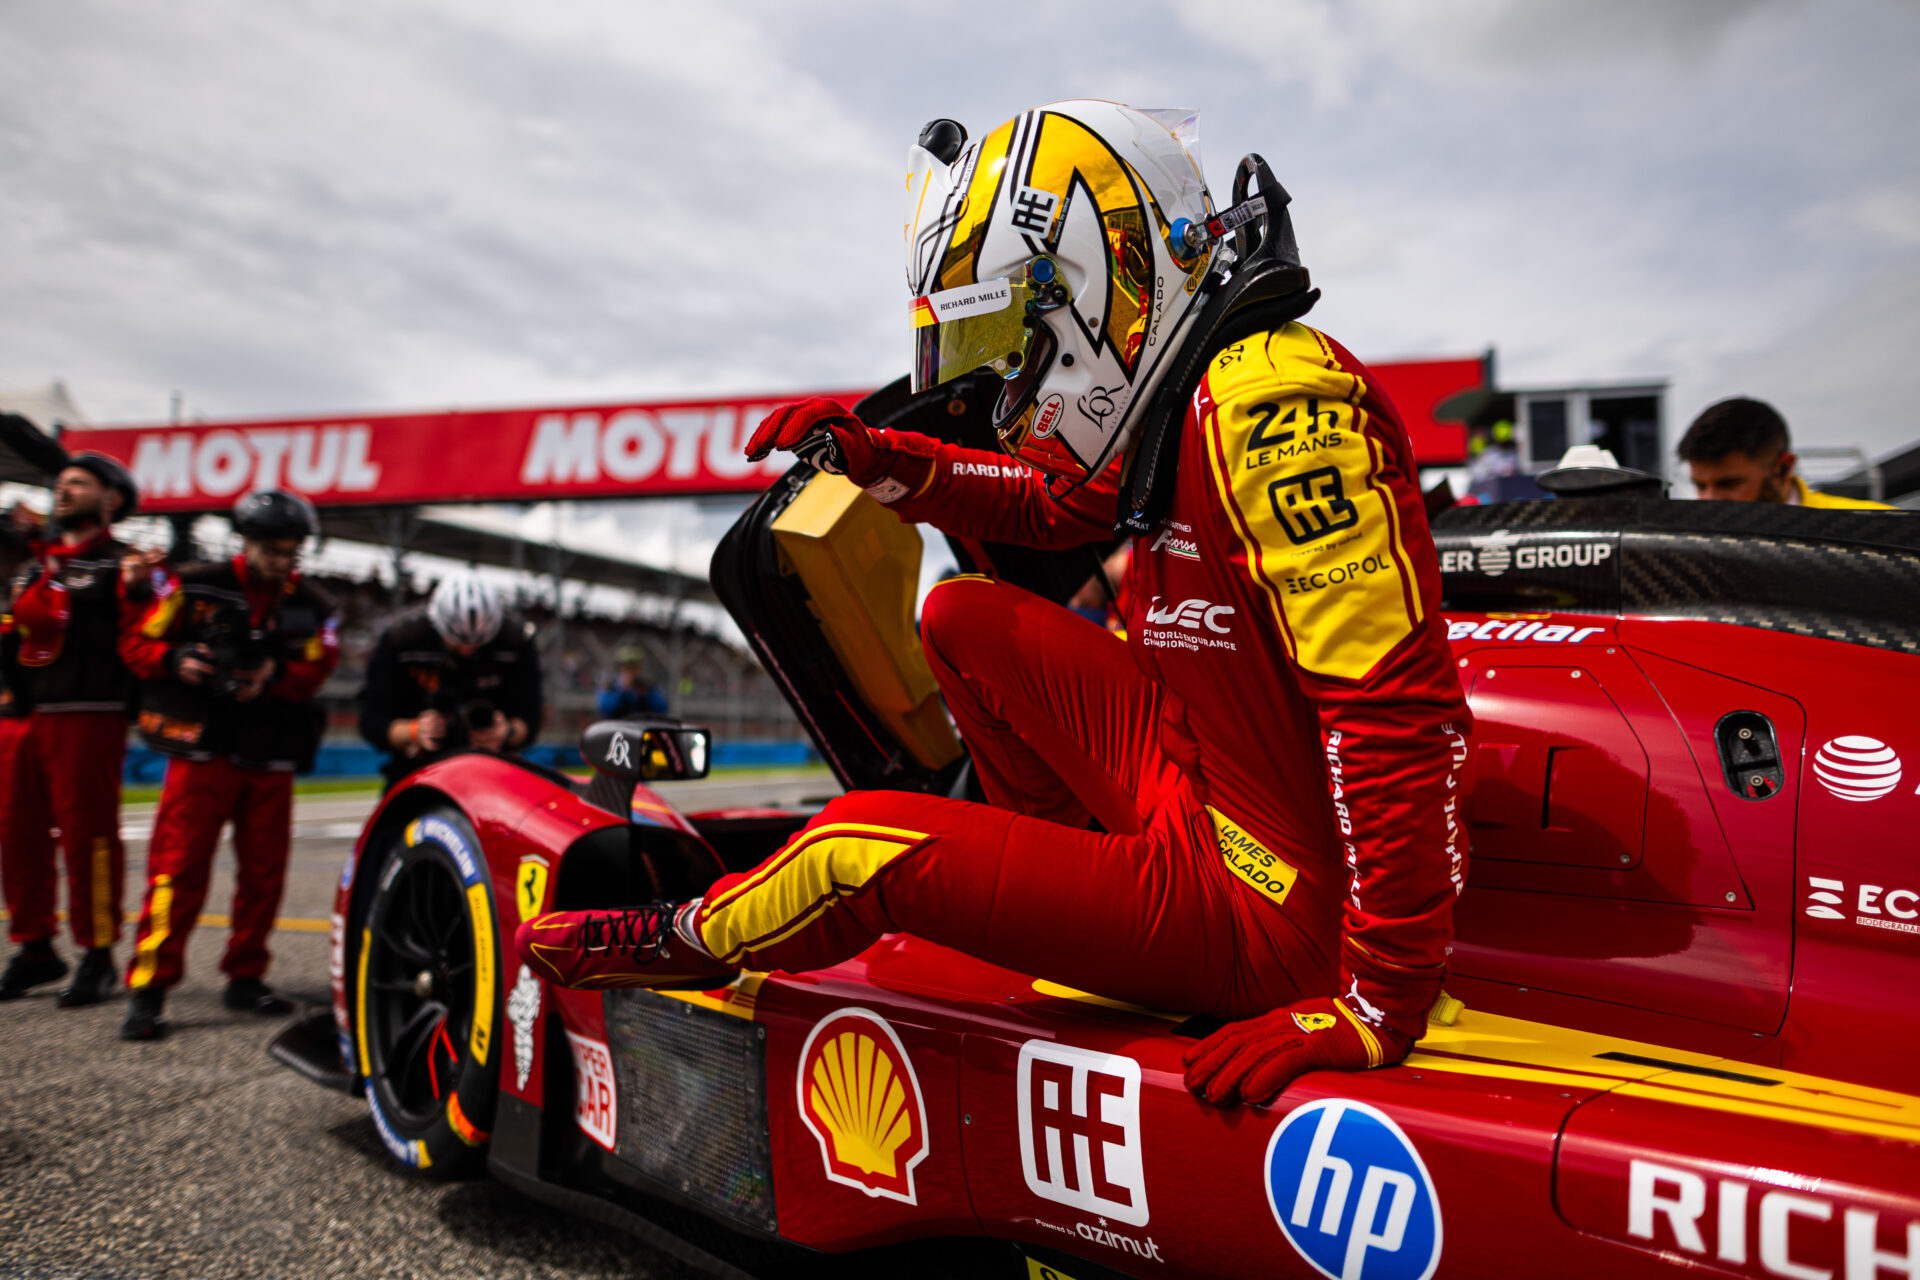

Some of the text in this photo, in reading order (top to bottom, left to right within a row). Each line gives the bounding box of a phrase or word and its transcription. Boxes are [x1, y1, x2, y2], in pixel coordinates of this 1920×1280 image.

[940, 289, 1008, 312] RICHARD MILLE
[1148, 276, 1165, 347] CALADO
[1036, 401, 1060, 433] BELL
[1246, 398, 1339, 453] 24h
[131, 424, 382, 498] MOTUL
[1246, 432, 1342, 470] LE MANS
[1298, 553, 1390, 592] ECOPOL
[1515, 542, 1612, 570] GROUP
[1145, 595, 1236, 634] WEC
[1446, 619, 1606, 643] etilar
[1326, 730, 1352, 836] RICHARD
[1219, 838, 1285, 894] CALADO
[1290, 1104, 1418, 1280] hp
[1034, 1217, 1165, 1264] Powered by azimut
